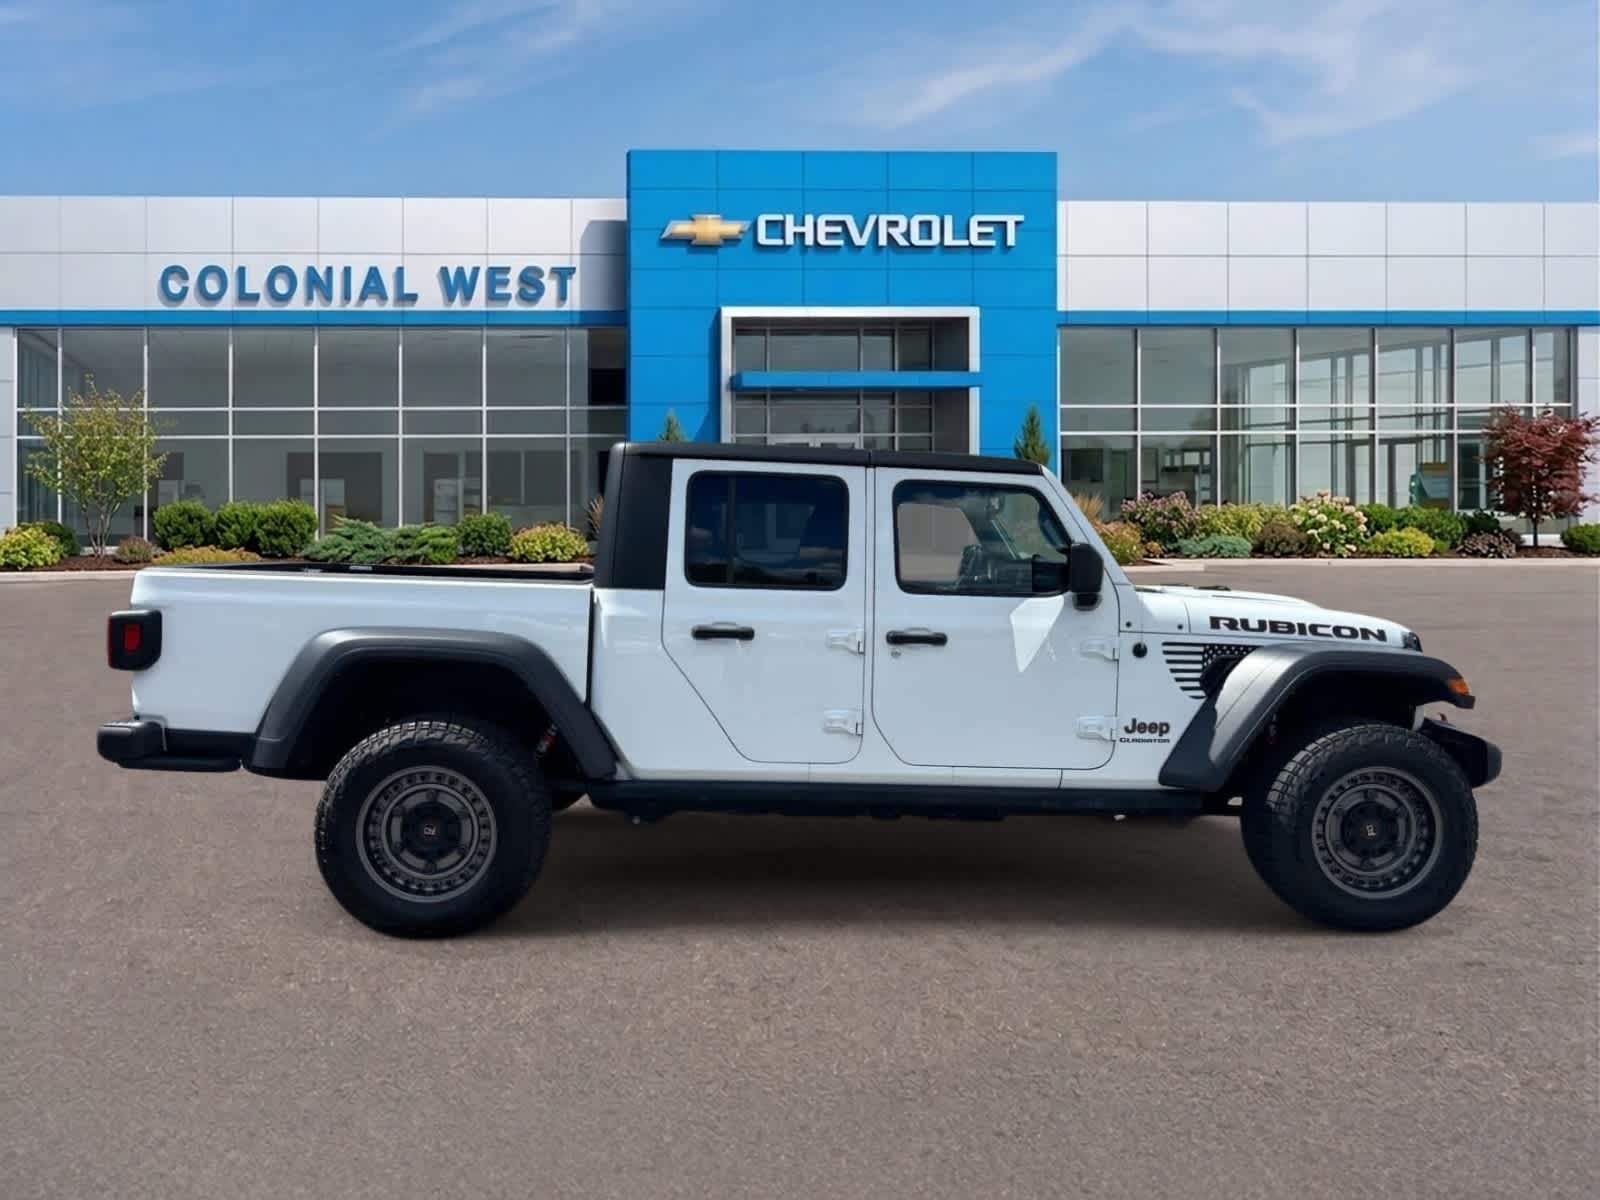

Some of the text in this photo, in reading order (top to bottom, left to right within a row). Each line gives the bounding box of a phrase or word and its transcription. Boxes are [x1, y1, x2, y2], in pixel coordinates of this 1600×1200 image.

[756, 213, 1025, 247] CHEVROLET
[160, 265, 577, 304] COLONIAL WEST
[1209, 616, 1388, 642] RUBICON
[1124, 717, 1170, 737] Jeep
